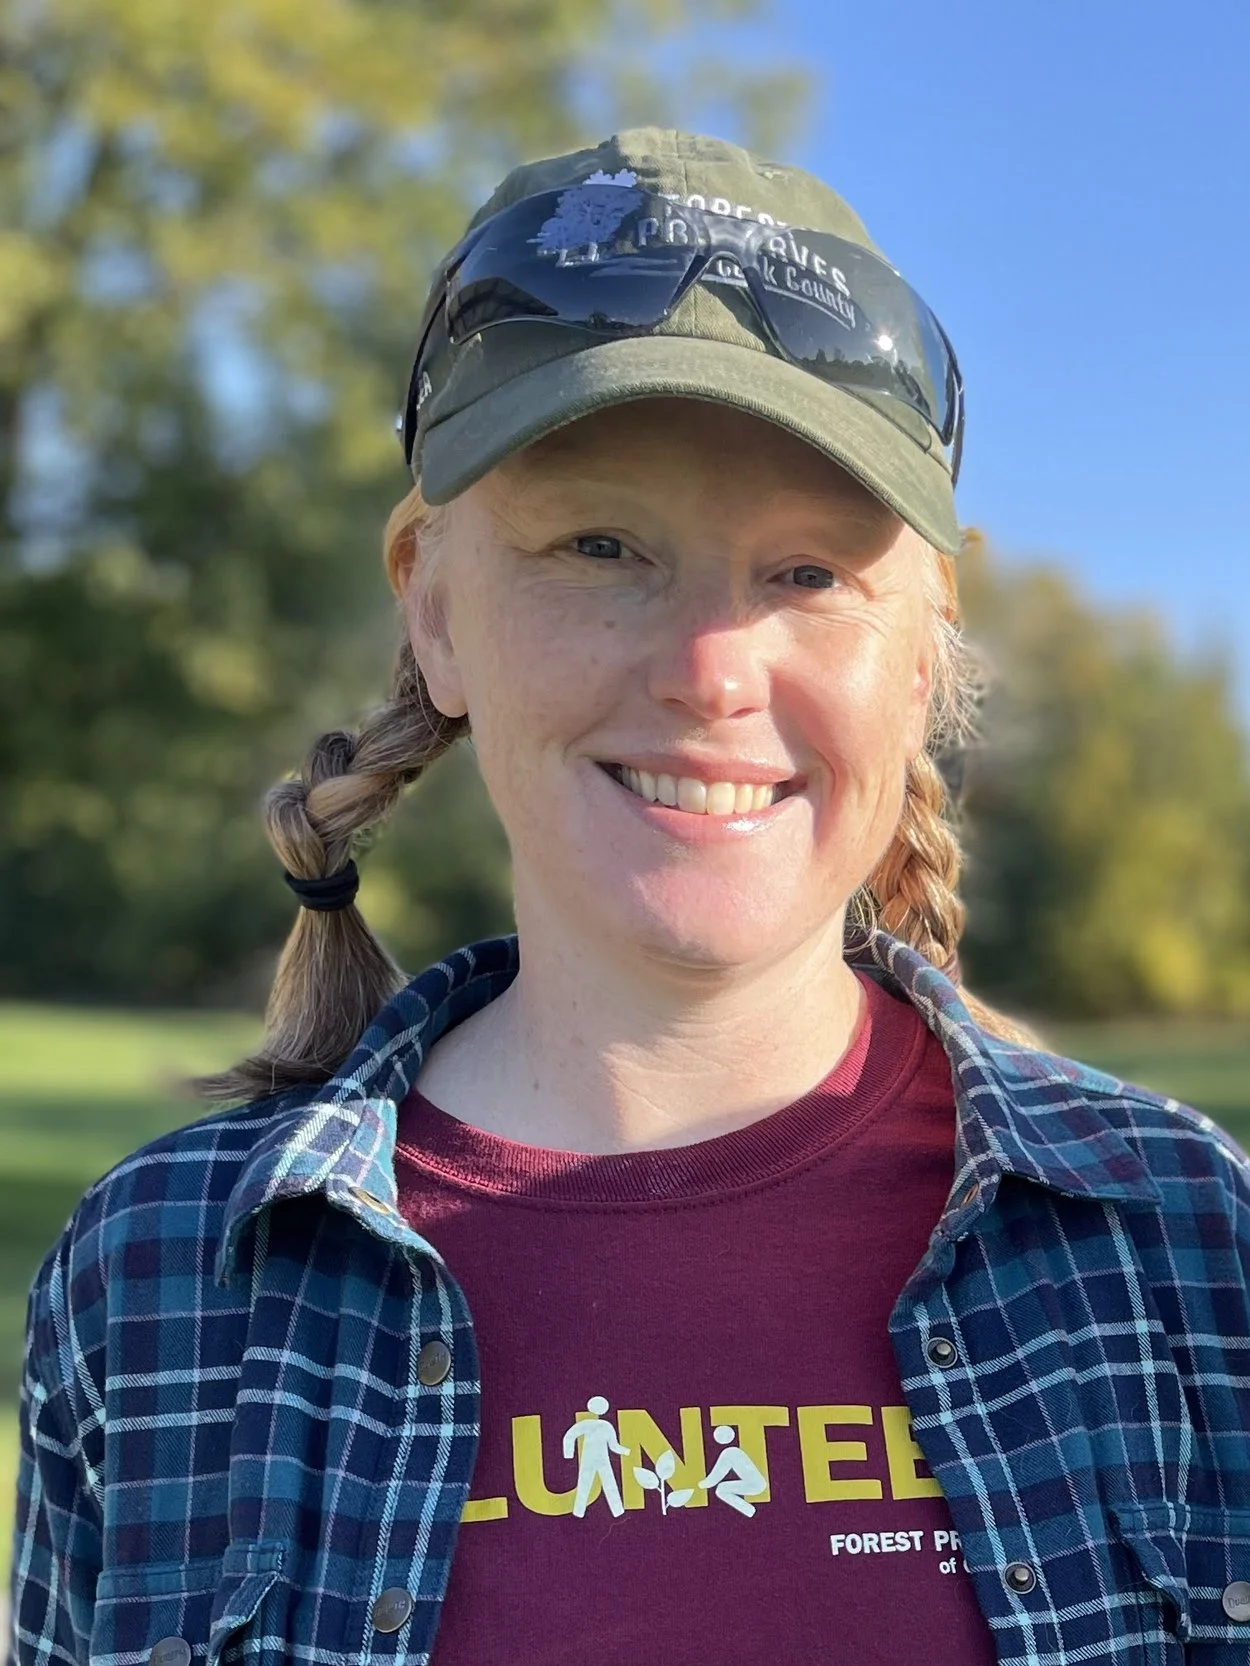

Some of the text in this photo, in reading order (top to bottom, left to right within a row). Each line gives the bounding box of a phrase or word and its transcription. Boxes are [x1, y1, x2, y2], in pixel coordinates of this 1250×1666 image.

[657, 191, 787, 226] FORE
[638, 217, 851, 298] PRRVES
[786, 266, 856, 328] County
[830, 1530, 924, 1555] FOREST
[939, 1557, 957, 1574] of
